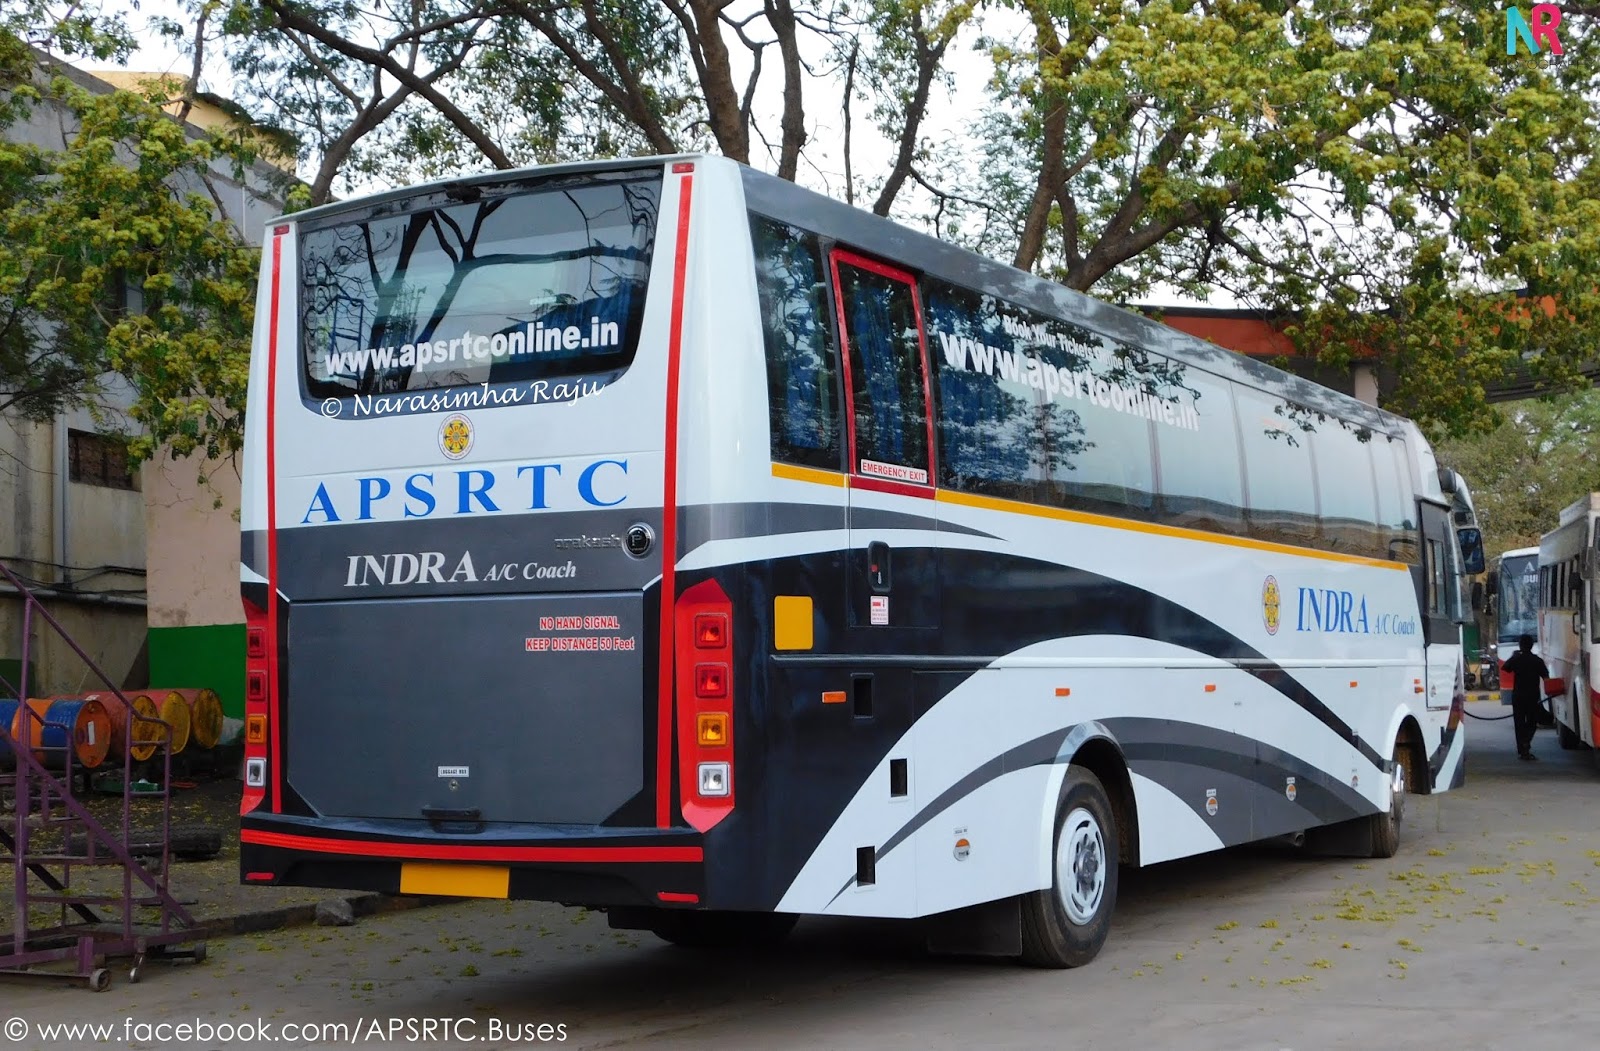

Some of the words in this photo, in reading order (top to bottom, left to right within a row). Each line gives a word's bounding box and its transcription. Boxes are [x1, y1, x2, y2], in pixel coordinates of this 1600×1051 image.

[324, 315, 619, 376] www.apsrtconline.in
[1002, 314, 1032, 341] Book
[1031, 323, 1056, 348] Your
[1056, 332, 1094, 359] Tickets
[939, 330, 1201, 432] www.apsrtconline.in
[862, 462, 907, 478] EMERGENCY
[909, 470, 925, 481] EXIT
[343, 550, 479, 587] INDRA
[483, 562, 518, 582] A/C
[522, 560, 577, 580] Coach
[540, 617, 554, 630] NO
[555, 616, 582, 630] HAND
[583, 616, 620, 629] SIGNAL
[1296, 587, 1369, 634] INDRA
[1373, 613, 1391, 635] A/C
[1392, 614, 1415, 635] Coach
[525, 638, 550, 651] KEEP
[551, 637, 599, 651] DISTANCE
[599, 637, 613, 650] 50
[613, 636, 635, 650] Feet
